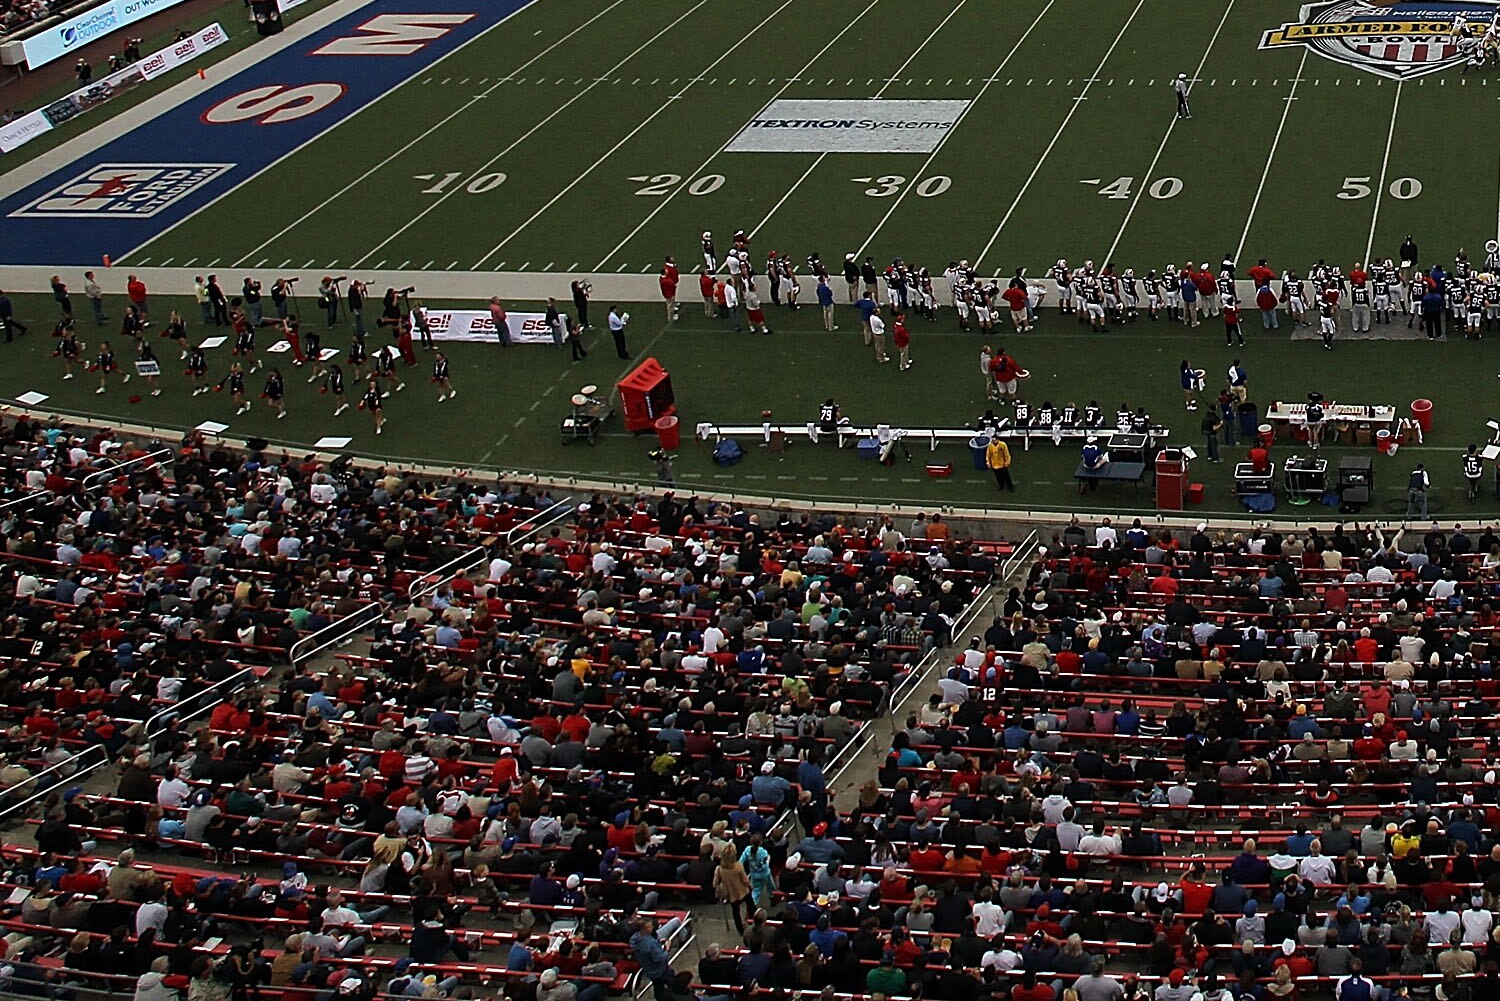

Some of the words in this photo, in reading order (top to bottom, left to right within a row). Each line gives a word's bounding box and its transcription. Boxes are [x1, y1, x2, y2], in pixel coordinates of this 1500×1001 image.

[125, 2, 141, 14] OUT
[76, 8, 114, 29] ClearChannel
[78, 17, 118, 39] OUTDOOR
[1294, 22, 1399, 36] ARMED
[1367, 35, 1450, 43] BOWL
[750, 119, 856, 128] TEXTRON
[856, 119, 952, 130] Systems
[108, 169, 192, 211] FORD
[136, 168, 218, 212] STADIUM
[422, 172, 508, 194] 10
[636, 174, 728, 196] 20
[865, 176, 952, 197] 30
[1097, 176, 1183, 199] 40
[1336, 177, 1423, 200] 50
[820, 409, 832, 421] 79
[1016, 408, 1027, 419] 89
[1040, 412, 1052, 424] 88
[1087, 410, 1093, 422] 3
[1468, 462, 1477, 472] 15
[30, 640, 44, 655] 12
[983, 688, 996, 701] 12
